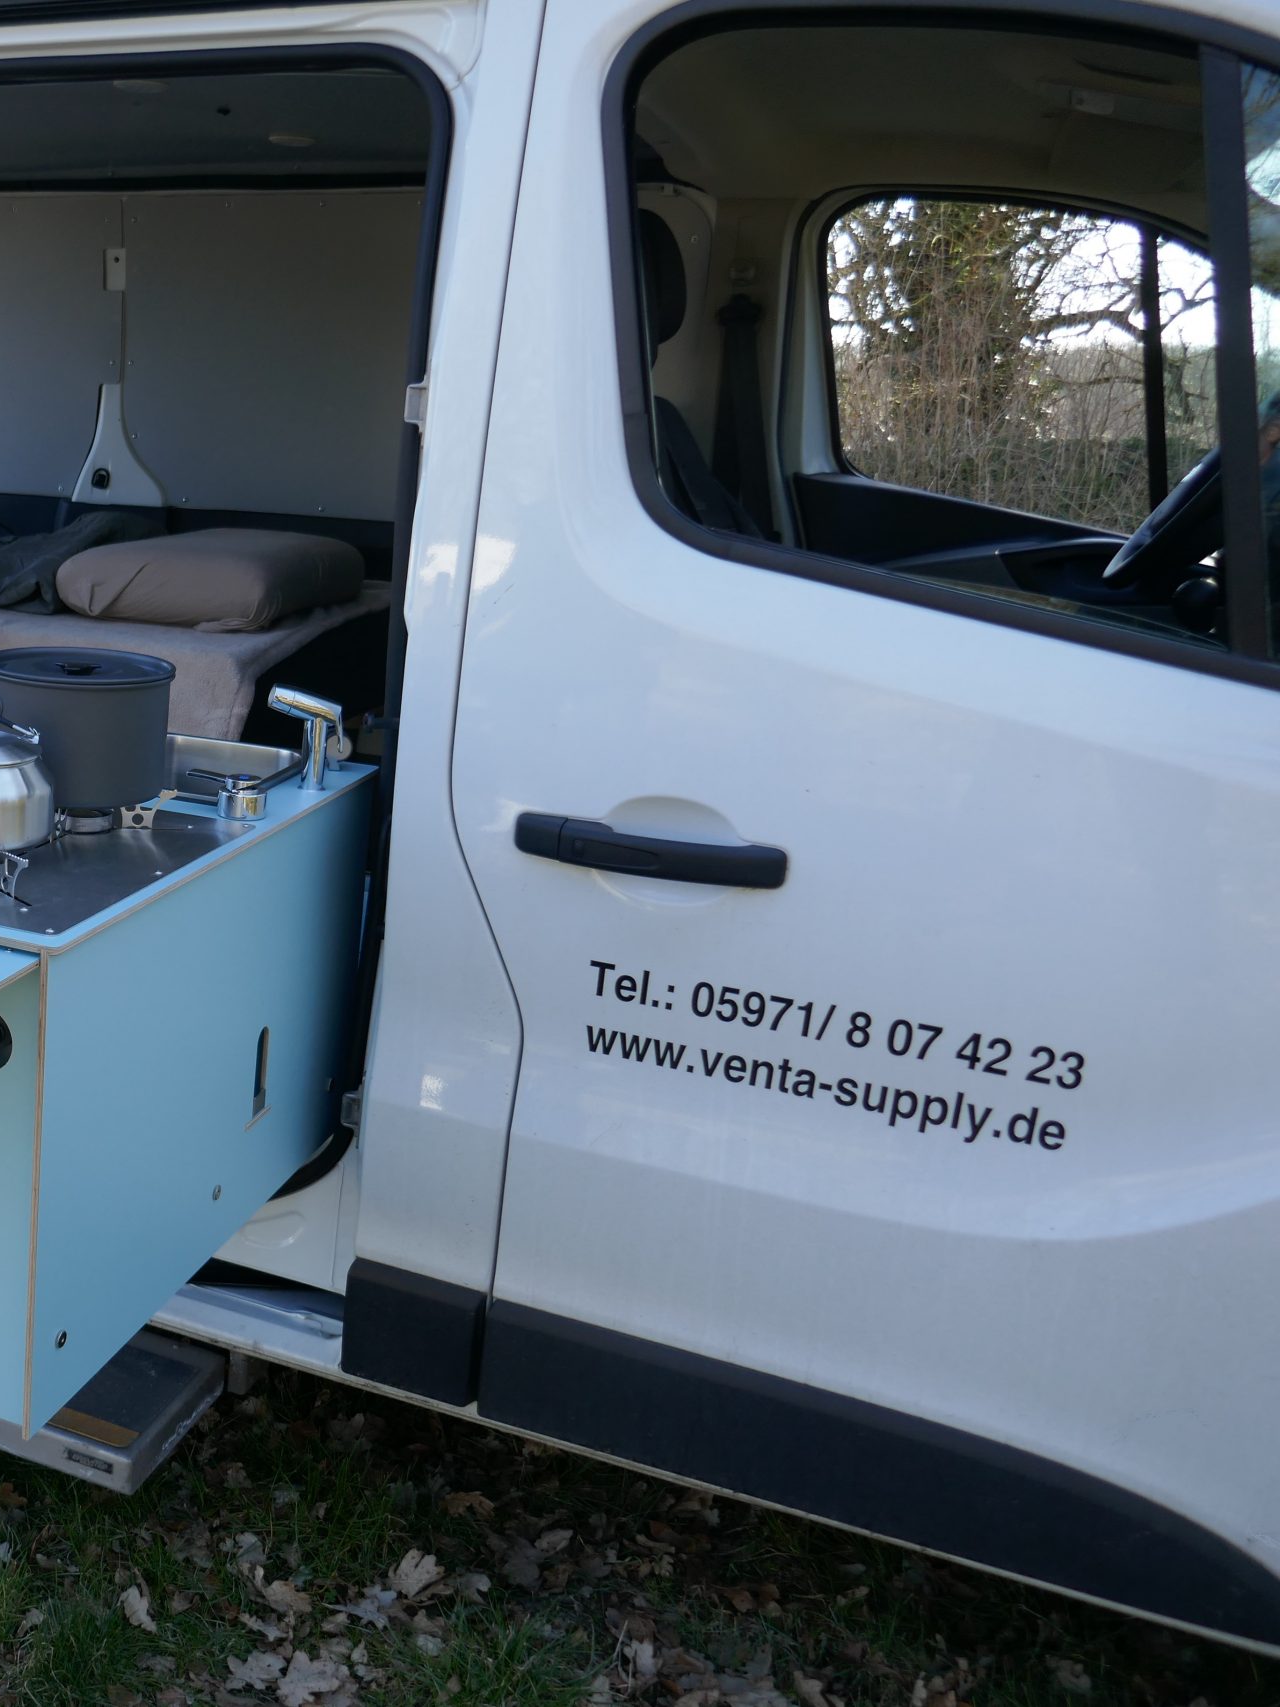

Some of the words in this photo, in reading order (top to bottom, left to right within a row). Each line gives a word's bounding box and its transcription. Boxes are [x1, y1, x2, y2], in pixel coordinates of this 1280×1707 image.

[585, 1024, 1067, 1151] www.venta-supply.de
[589, 959, 676, 1012] Tel.:
[691, 981, 837, 1041] 05971/
[845, 1011, 873, 1048] 8
[887, 1018, 944, 1060] 07
[955, 1032, 1012, 1076] 42
[1025, 1045, 1085, 1090] 23
